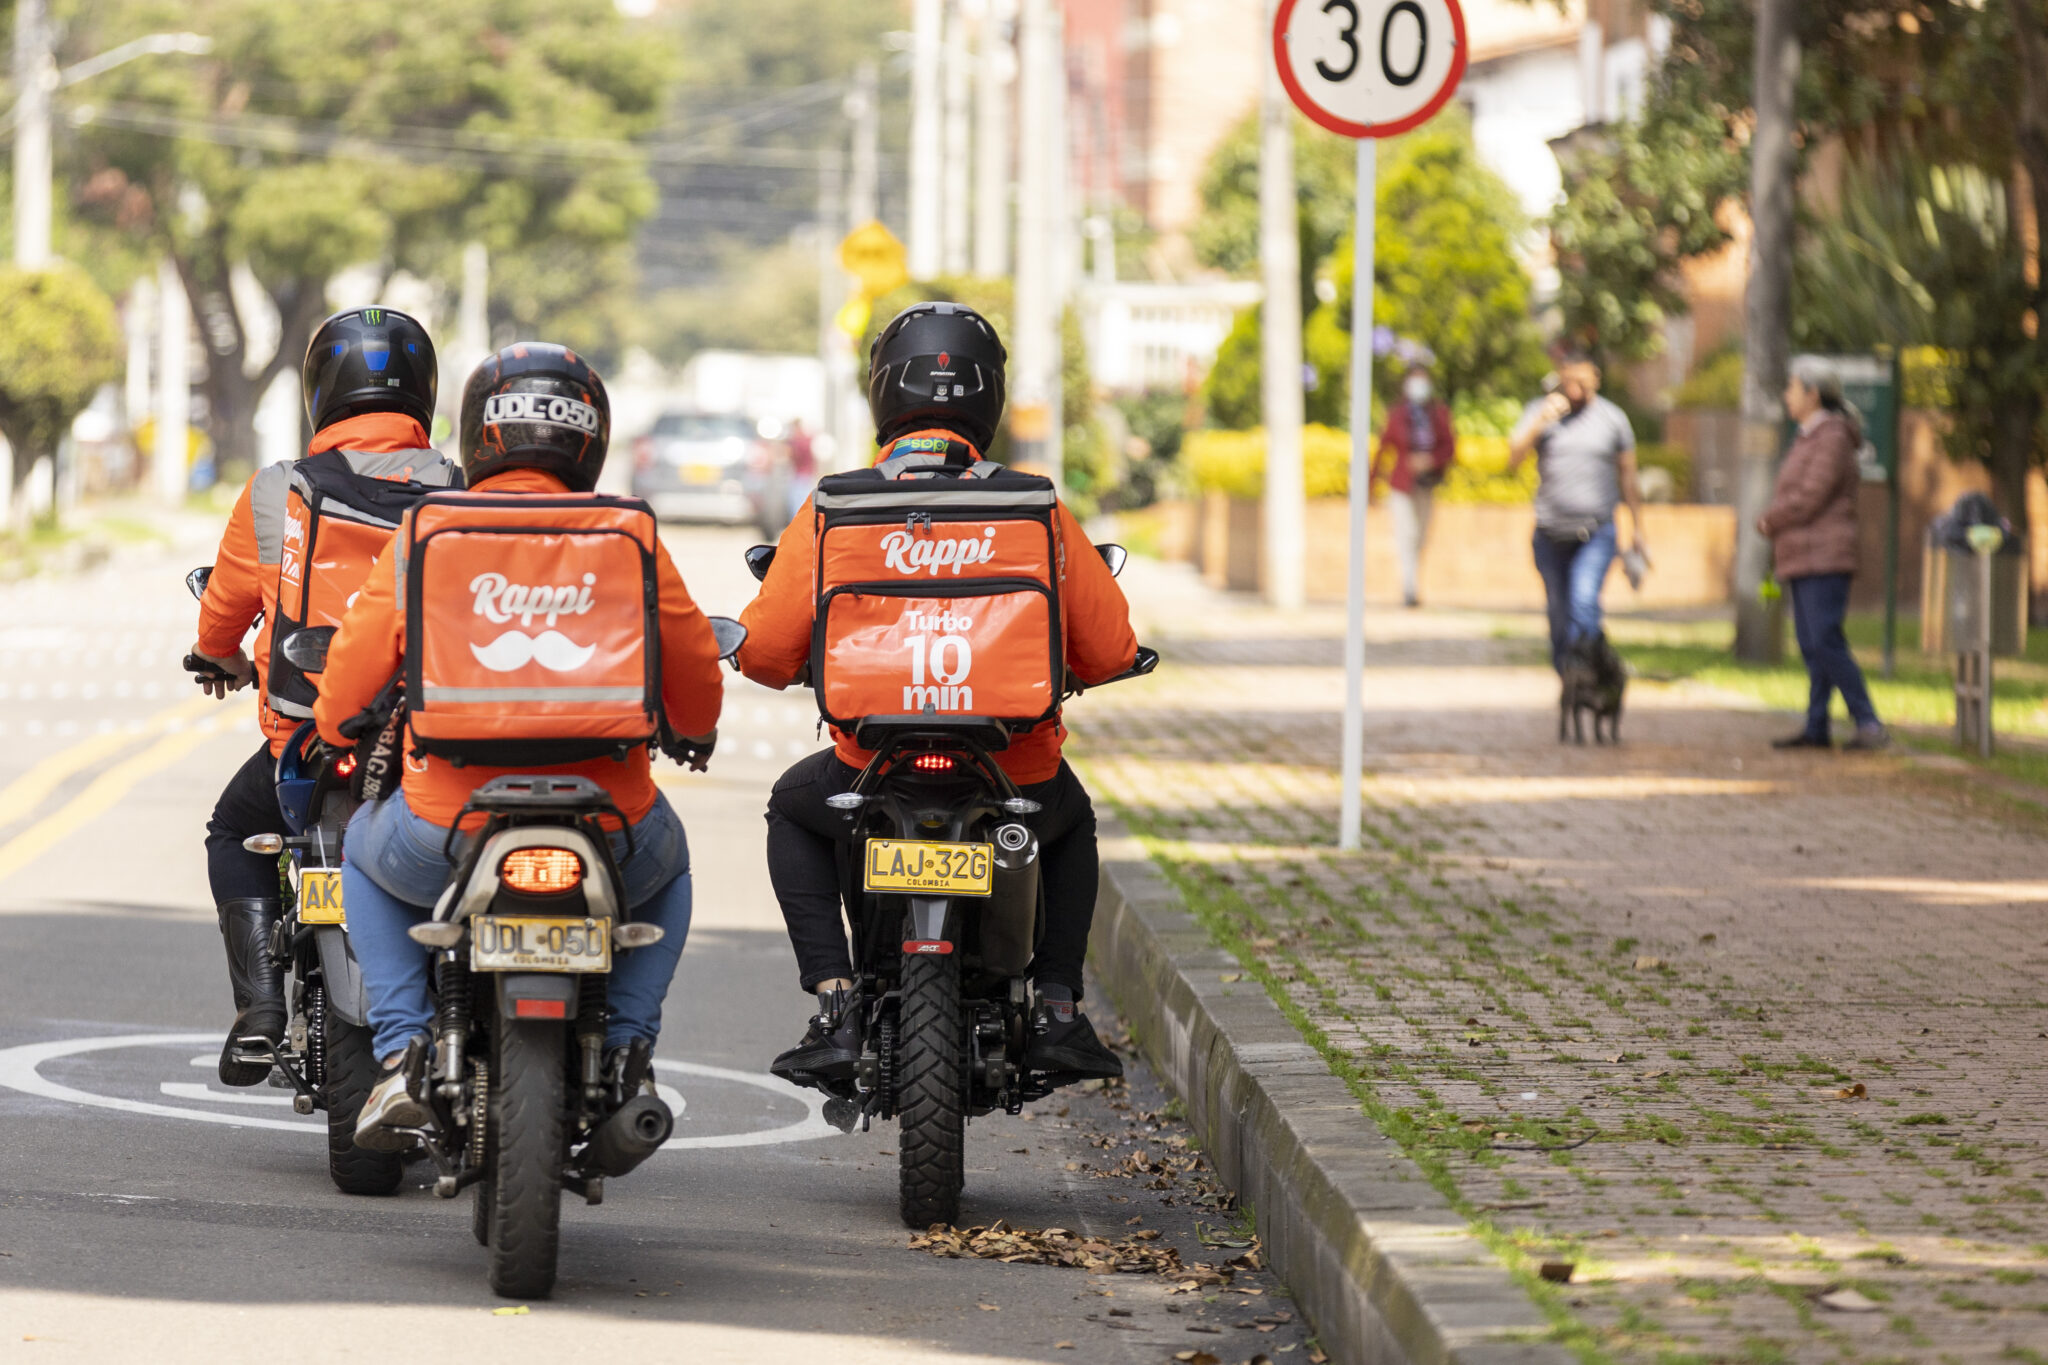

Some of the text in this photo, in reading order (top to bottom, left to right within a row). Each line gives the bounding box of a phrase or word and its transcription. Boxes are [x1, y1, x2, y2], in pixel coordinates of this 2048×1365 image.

[1315, 0, 1428, 86] 30
[487, 395, 598, 431] UDL-05D
[879, 526, 996, 576] Rappi
[469, 572, 597, 628] Rappi
[905, 611, 973, 631] Turbo
[903, 635, 973, 686] 10
[903, 676, 973, 710] min
[906, 878, 951, 887] COLOMBIA
